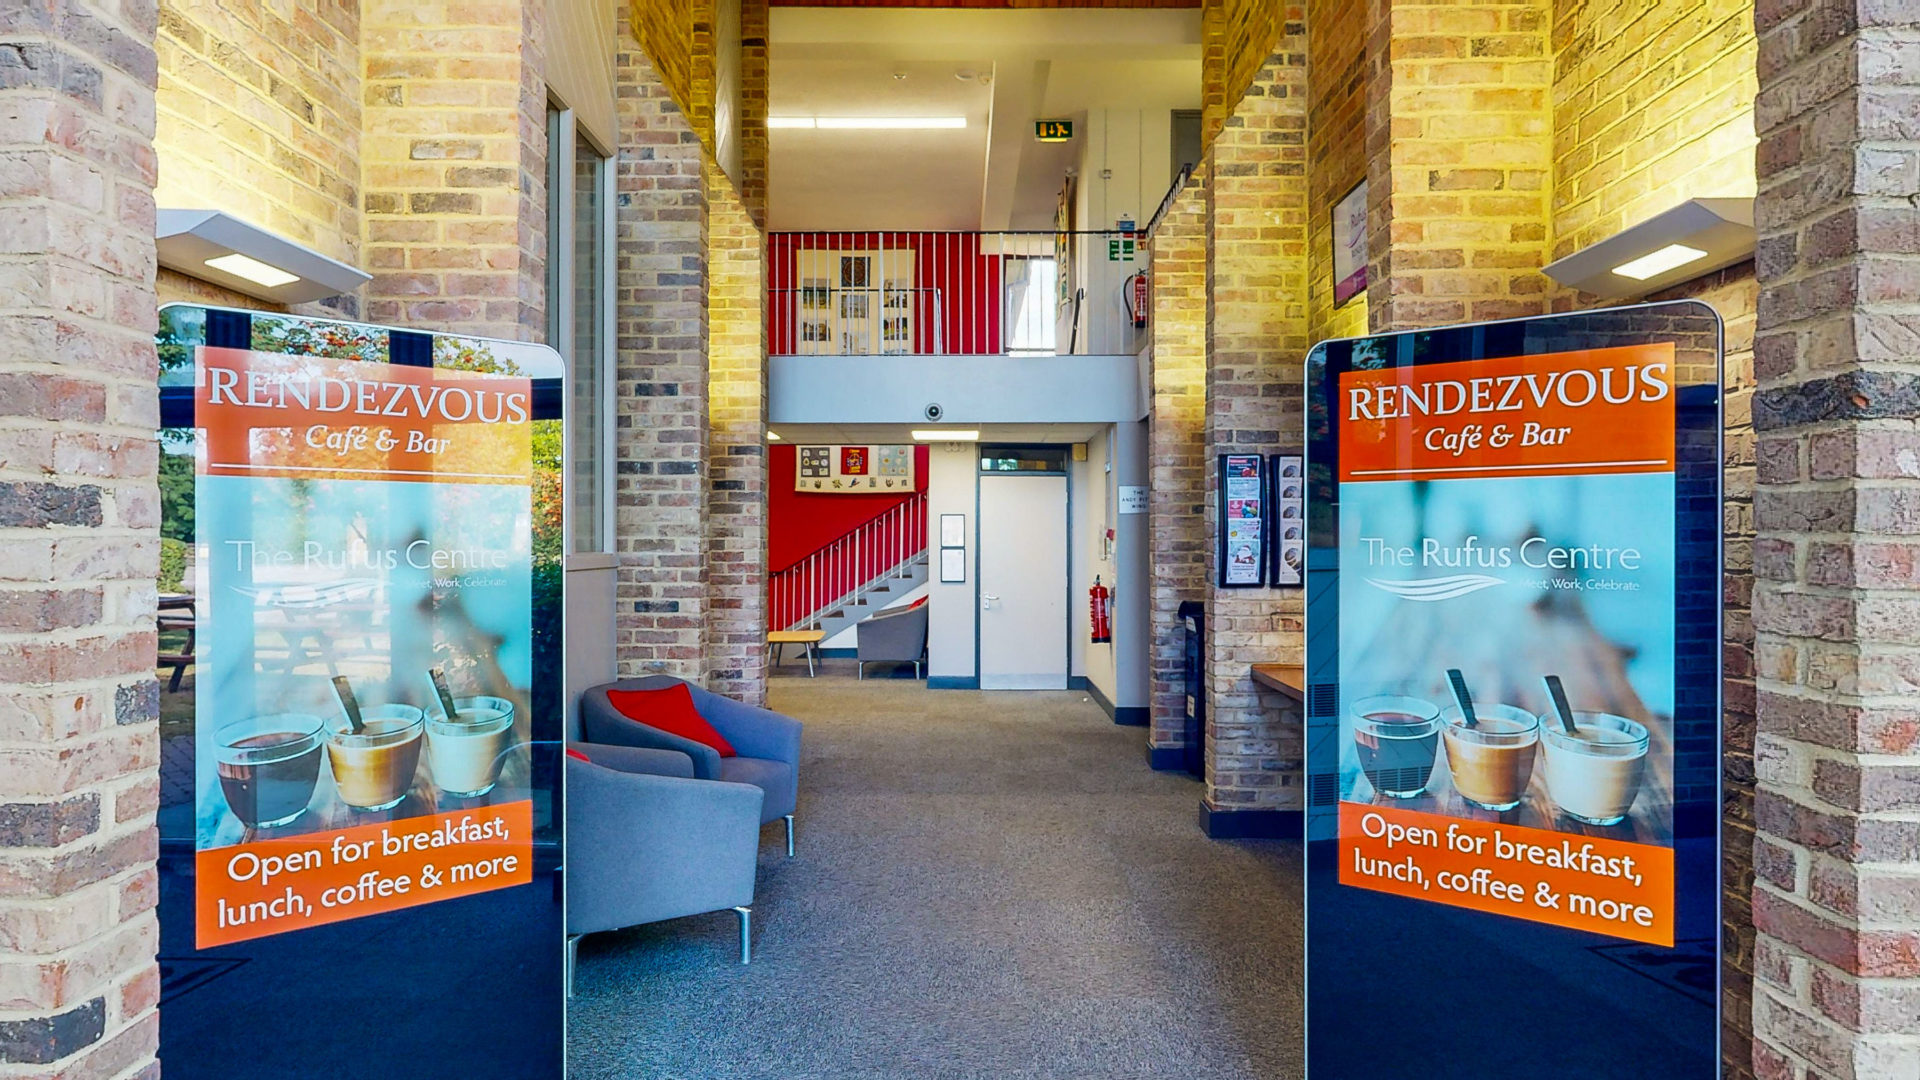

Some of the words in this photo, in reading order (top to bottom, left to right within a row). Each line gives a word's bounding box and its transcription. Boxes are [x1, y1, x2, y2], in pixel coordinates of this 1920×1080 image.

[208, 366, 528, 425] RENDEZVOUS
[1348, 363, 1669, 422] RENDEZVOUS
[305, 424, 368, 456] Café
[375, 429, 399, 451] &
[405, 430, 450, 454] Bar
[1424, 424, 1482, 456] Café
[1489, 424, 1513, 448] &
[1520, 422, 1571, 447] Bar
[224, 540, 293, 571] The
[303, 538, 397, 570] Rufus
[406, 540, 508, 570] Centre
[1360, 537, 1414, 567] The
[1422, 535, 1512, 568] Rufus
[1519, 537, 1641, 570] Centre
[434, 577, 462, 589] Work,
[464, 577, 508, 588] Celebrate
[1551, 578, 1583, 591] Work,
[1586, 578, 1640, 591] Celebrate
[227, 851, 322, 885] Open
[331, 836, 374, 865] for
[382, 815, 510, 857] breakfast,
[1361, 812, 1438, 848] Open
[1446, 824, 1488, 855] for
[1495, 832, 1642, 886] breakfast,
[217, 887, 313, 929] lunch,
[320, 872, 411, 909] coffee
[419, 864, 442, 889] &
[450, 853, 519, 883] more
[1354, 848, 1430, 891] lunch,
[1437, 869, 1525, 903] coffee
[1534, 882, 1560, 909] &
[1569, 893, 1654, 927] more
